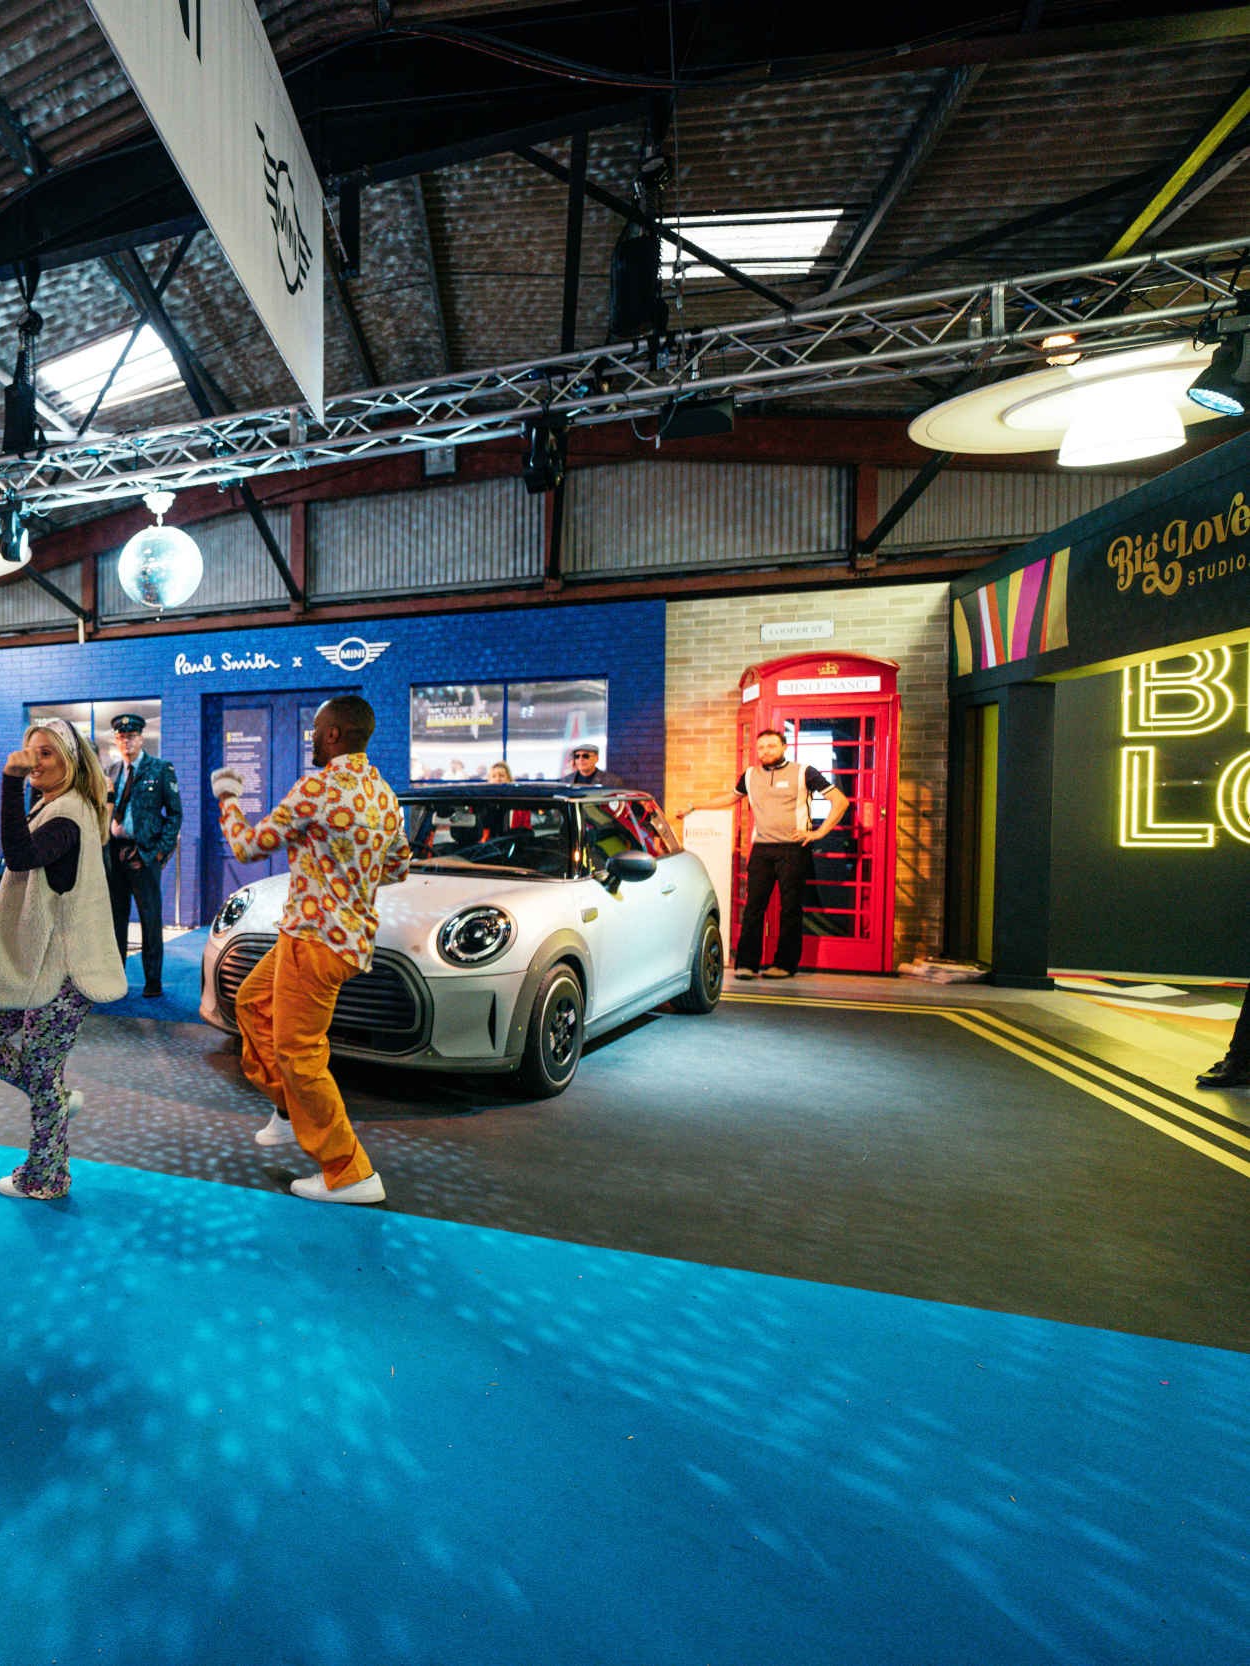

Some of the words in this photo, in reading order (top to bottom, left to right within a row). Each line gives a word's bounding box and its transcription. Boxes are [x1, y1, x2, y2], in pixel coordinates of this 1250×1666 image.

[1107, 531, 1183, 596] Big
[1162, 491, 1250, 559] Love
[174, 652, 216, 676] Paul
[221, 652, 281, 670] Smith
[340, 649, 365, 660] MINI
